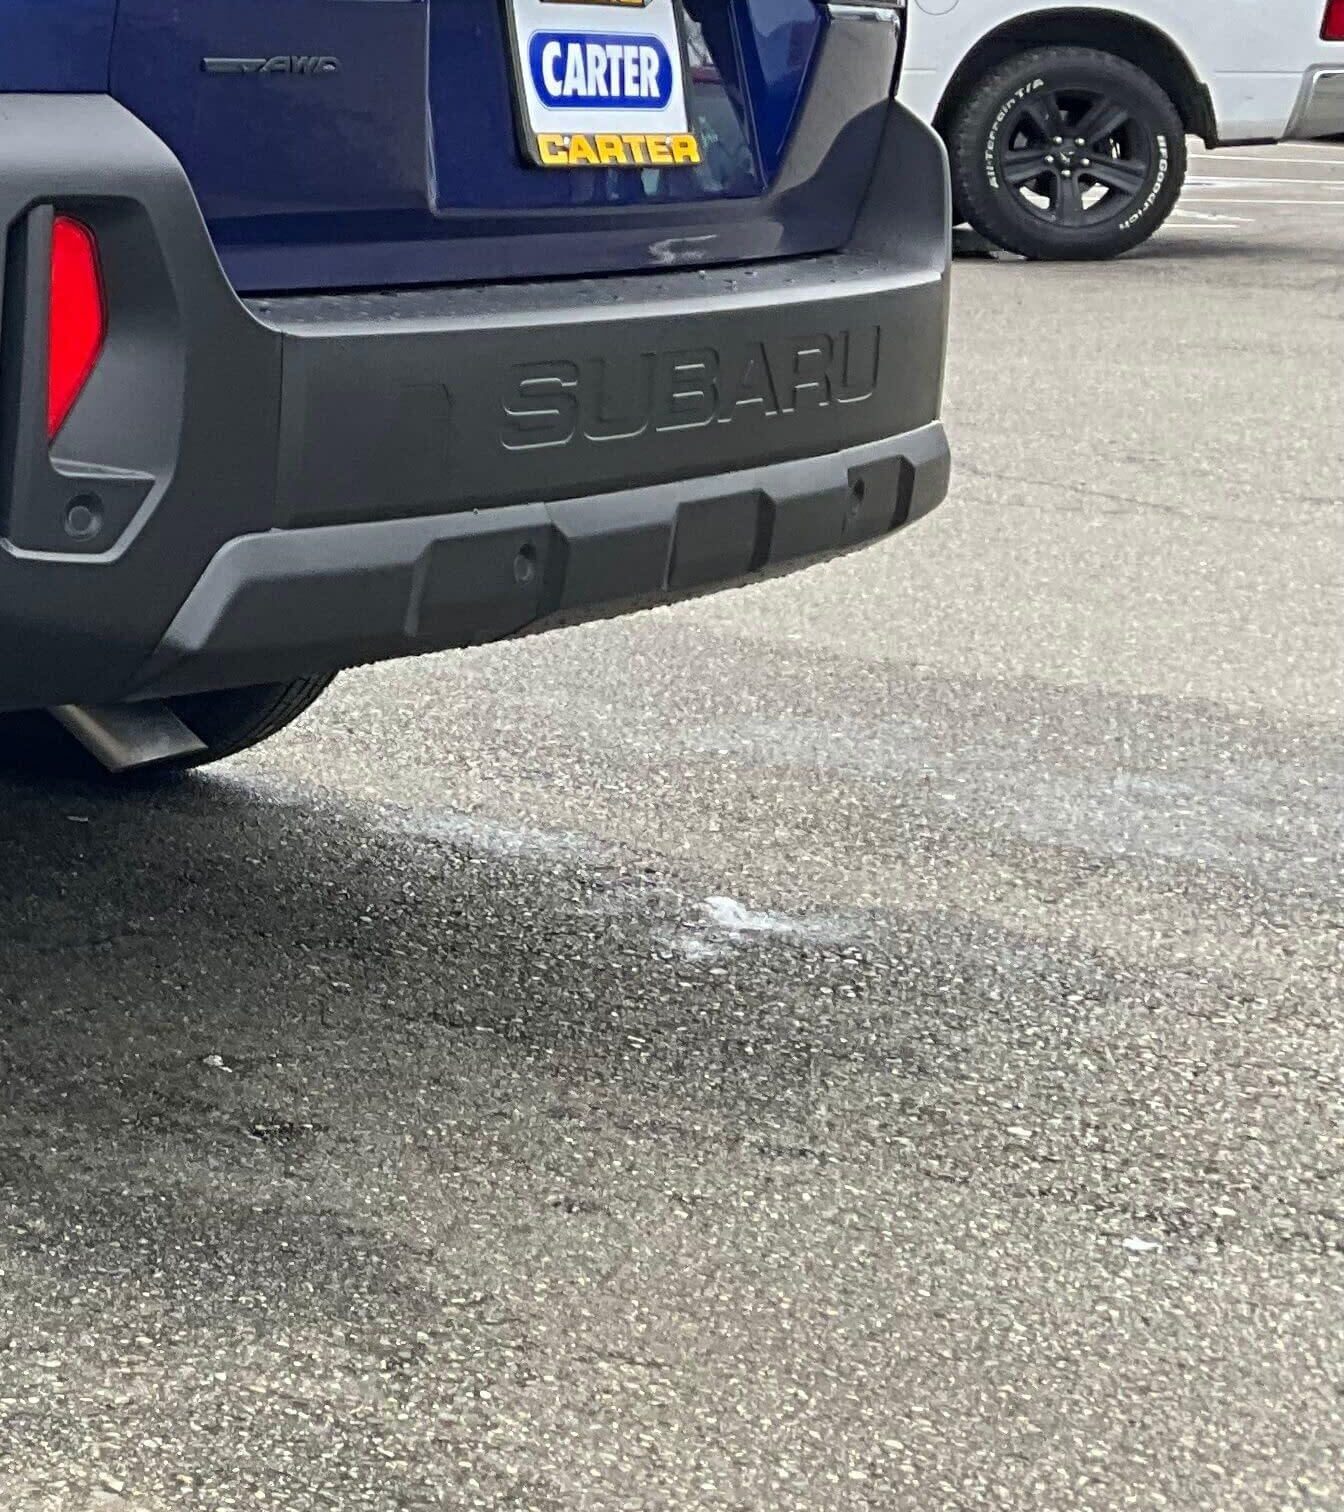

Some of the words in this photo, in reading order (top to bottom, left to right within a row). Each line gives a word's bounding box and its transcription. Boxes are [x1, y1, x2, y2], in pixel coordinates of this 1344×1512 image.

[541, 41, 660, 98] CARTER
[536, 133, 701, 165] CARTER
[501, 325, 881, 451] SUBARU
